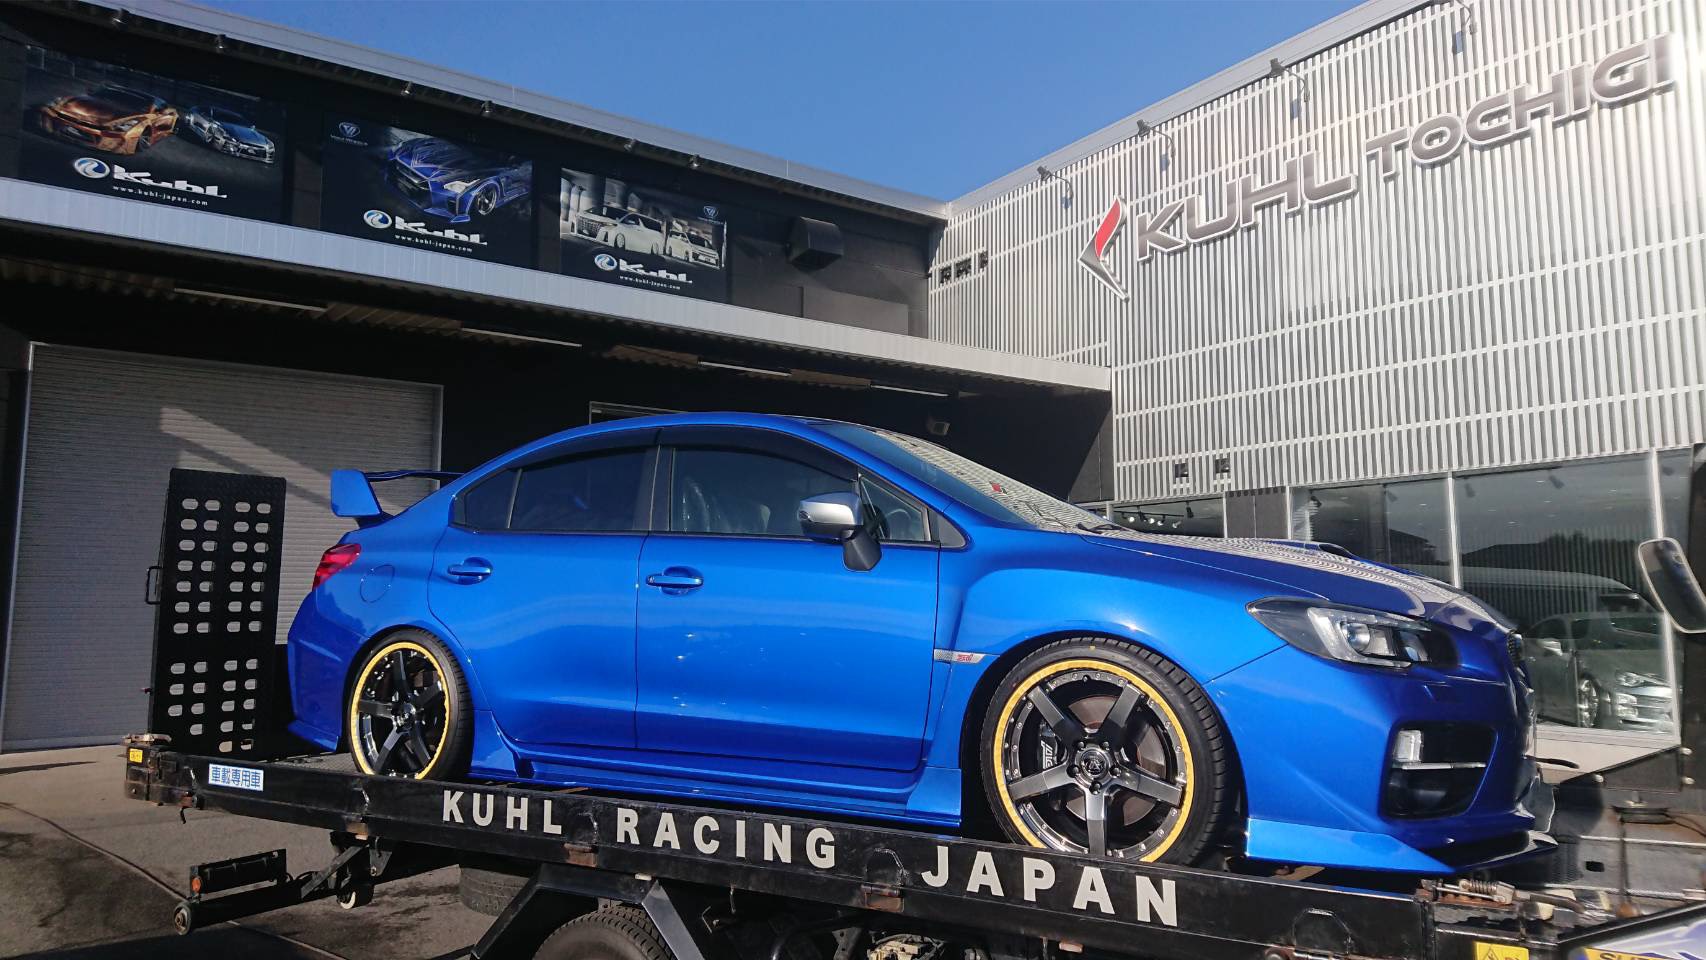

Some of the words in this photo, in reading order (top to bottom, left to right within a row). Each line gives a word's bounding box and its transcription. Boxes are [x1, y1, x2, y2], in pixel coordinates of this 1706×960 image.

[1136, 150, 1358, 262] KUHL
[1366, 31, 1676, 179] TOCHIGI
[113, 185, 208, 206] www.kuhl-japan.com
[395, 234, 473, 252] www.kuhl-japan.com
[442, 789, 562, 835] KUHL
[616, 807, 836, 869] RACING
[920, 845, 1178, 927] JAPAN
